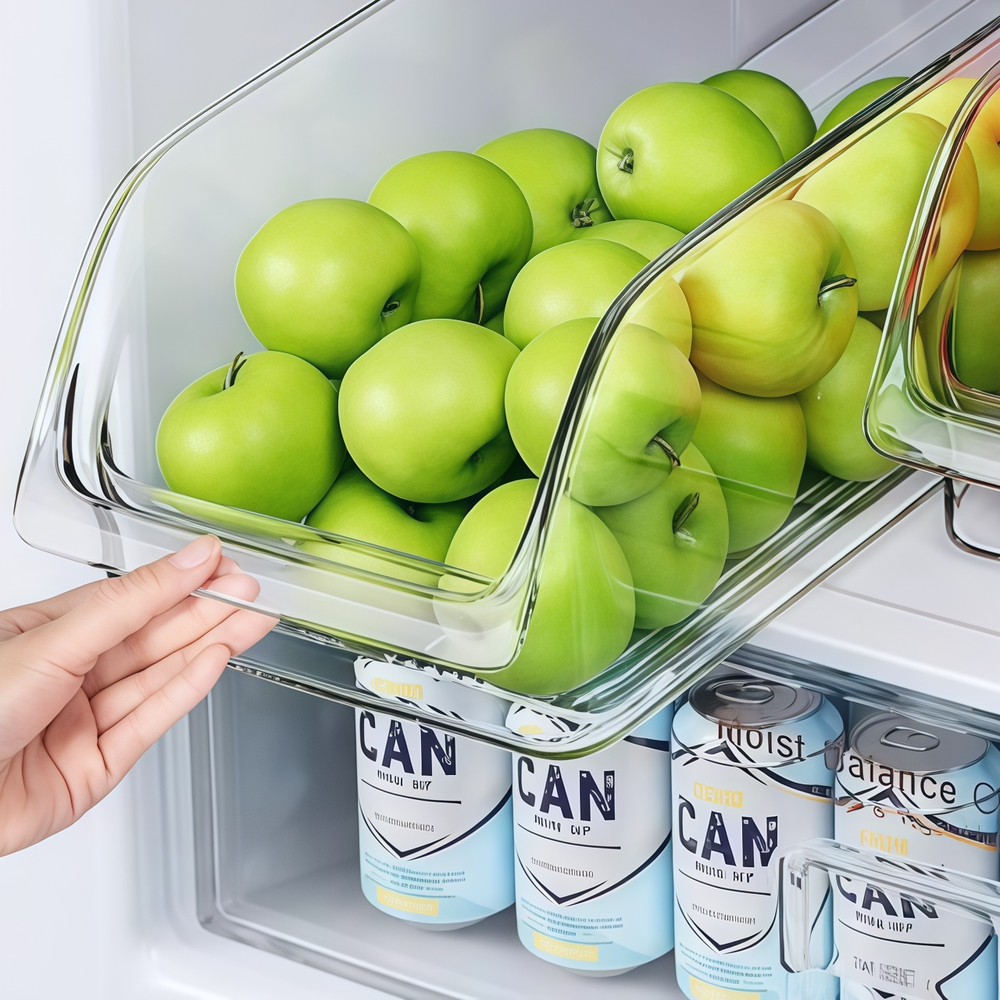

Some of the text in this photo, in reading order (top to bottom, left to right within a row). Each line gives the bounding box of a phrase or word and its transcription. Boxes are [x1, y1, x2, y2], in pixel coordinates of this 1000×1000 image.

[359, 710, 457, 777] CAN
[517, 756, 616, 821] CAN
[678, 796, 778, 868] CAN
